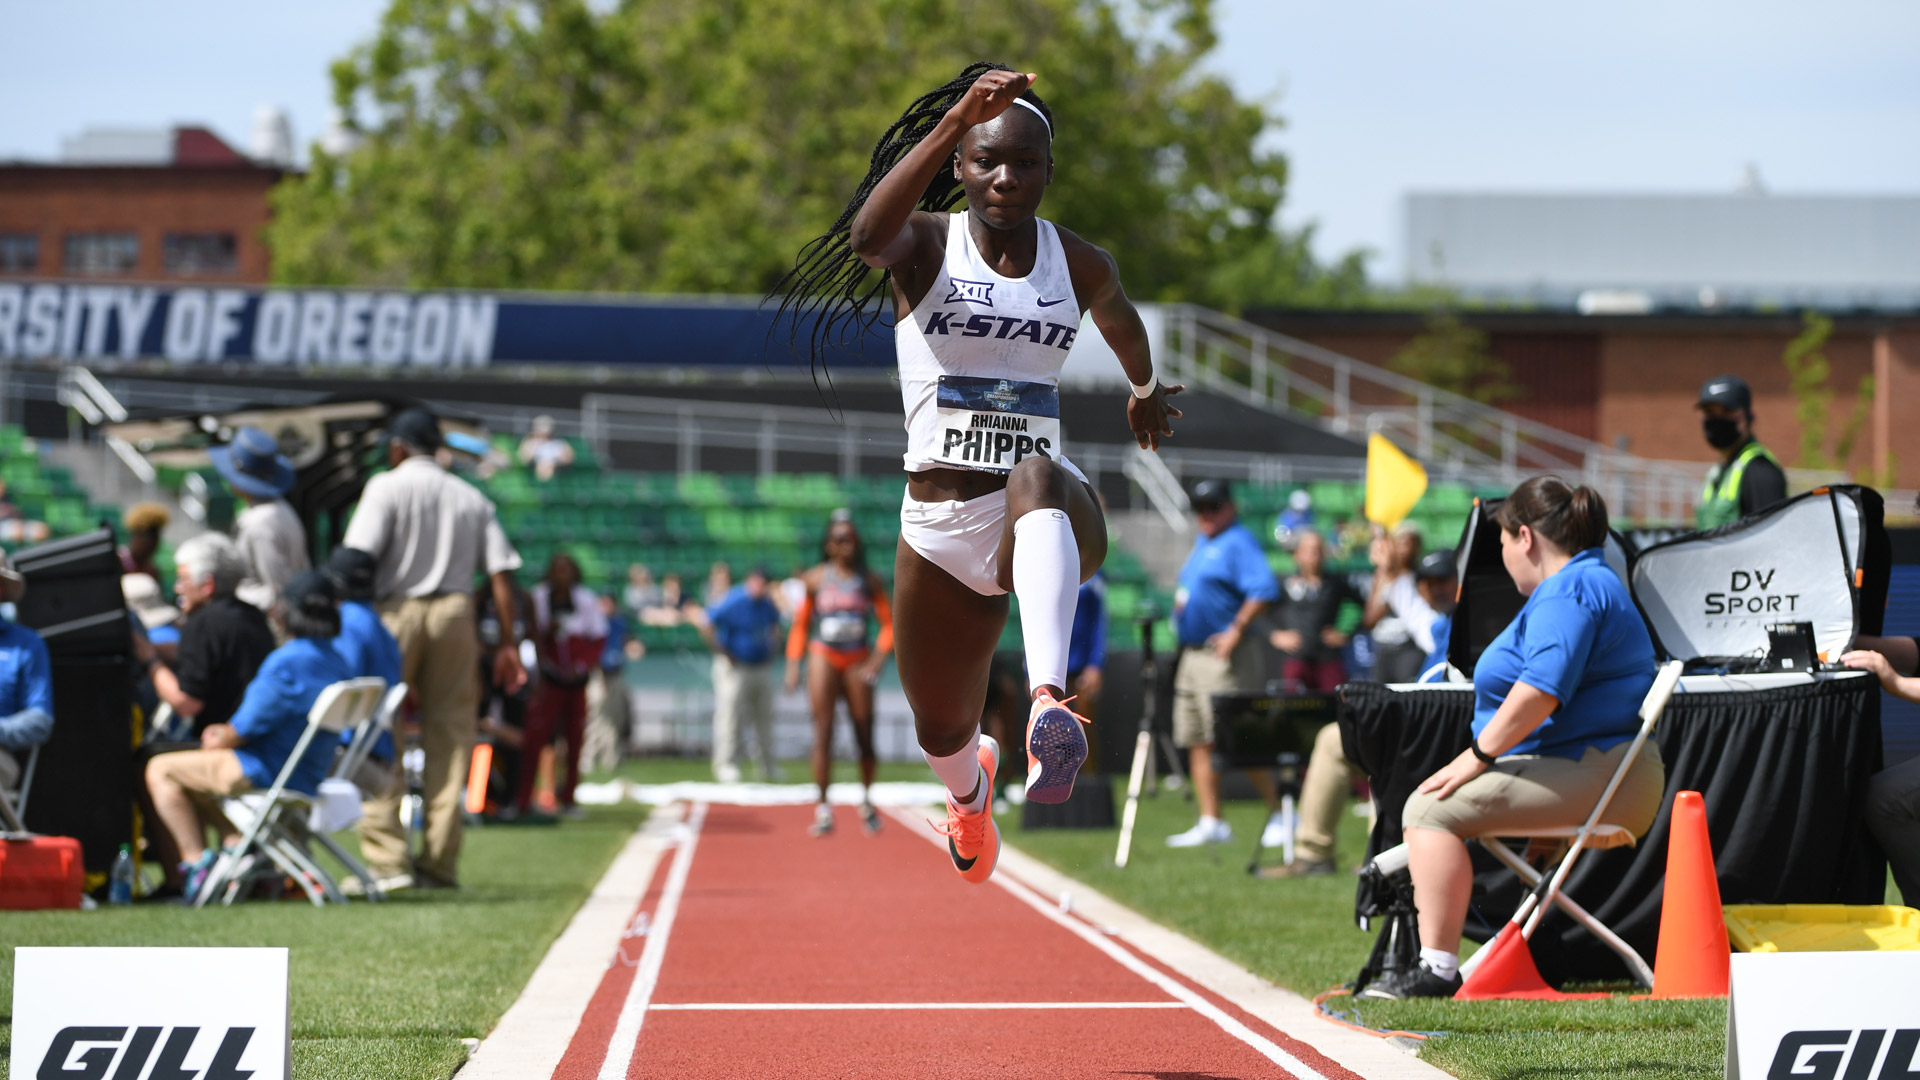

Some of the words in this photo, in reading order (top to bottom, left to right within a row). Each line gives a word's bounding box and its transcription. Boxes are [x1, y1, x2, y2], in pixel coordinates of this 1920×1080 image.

[163, 286, 248, 363] OF
[252, 289, 500, 369] OREGON
[924, 312, 1077, 351] K-STATE
[971, 414, 1027, 432] RHIANNA
[942, 428, 1052, 466] PHIPPS
[1731, 568, 1775, 592] DV
[36, 1026, 256, 1080] GILL
